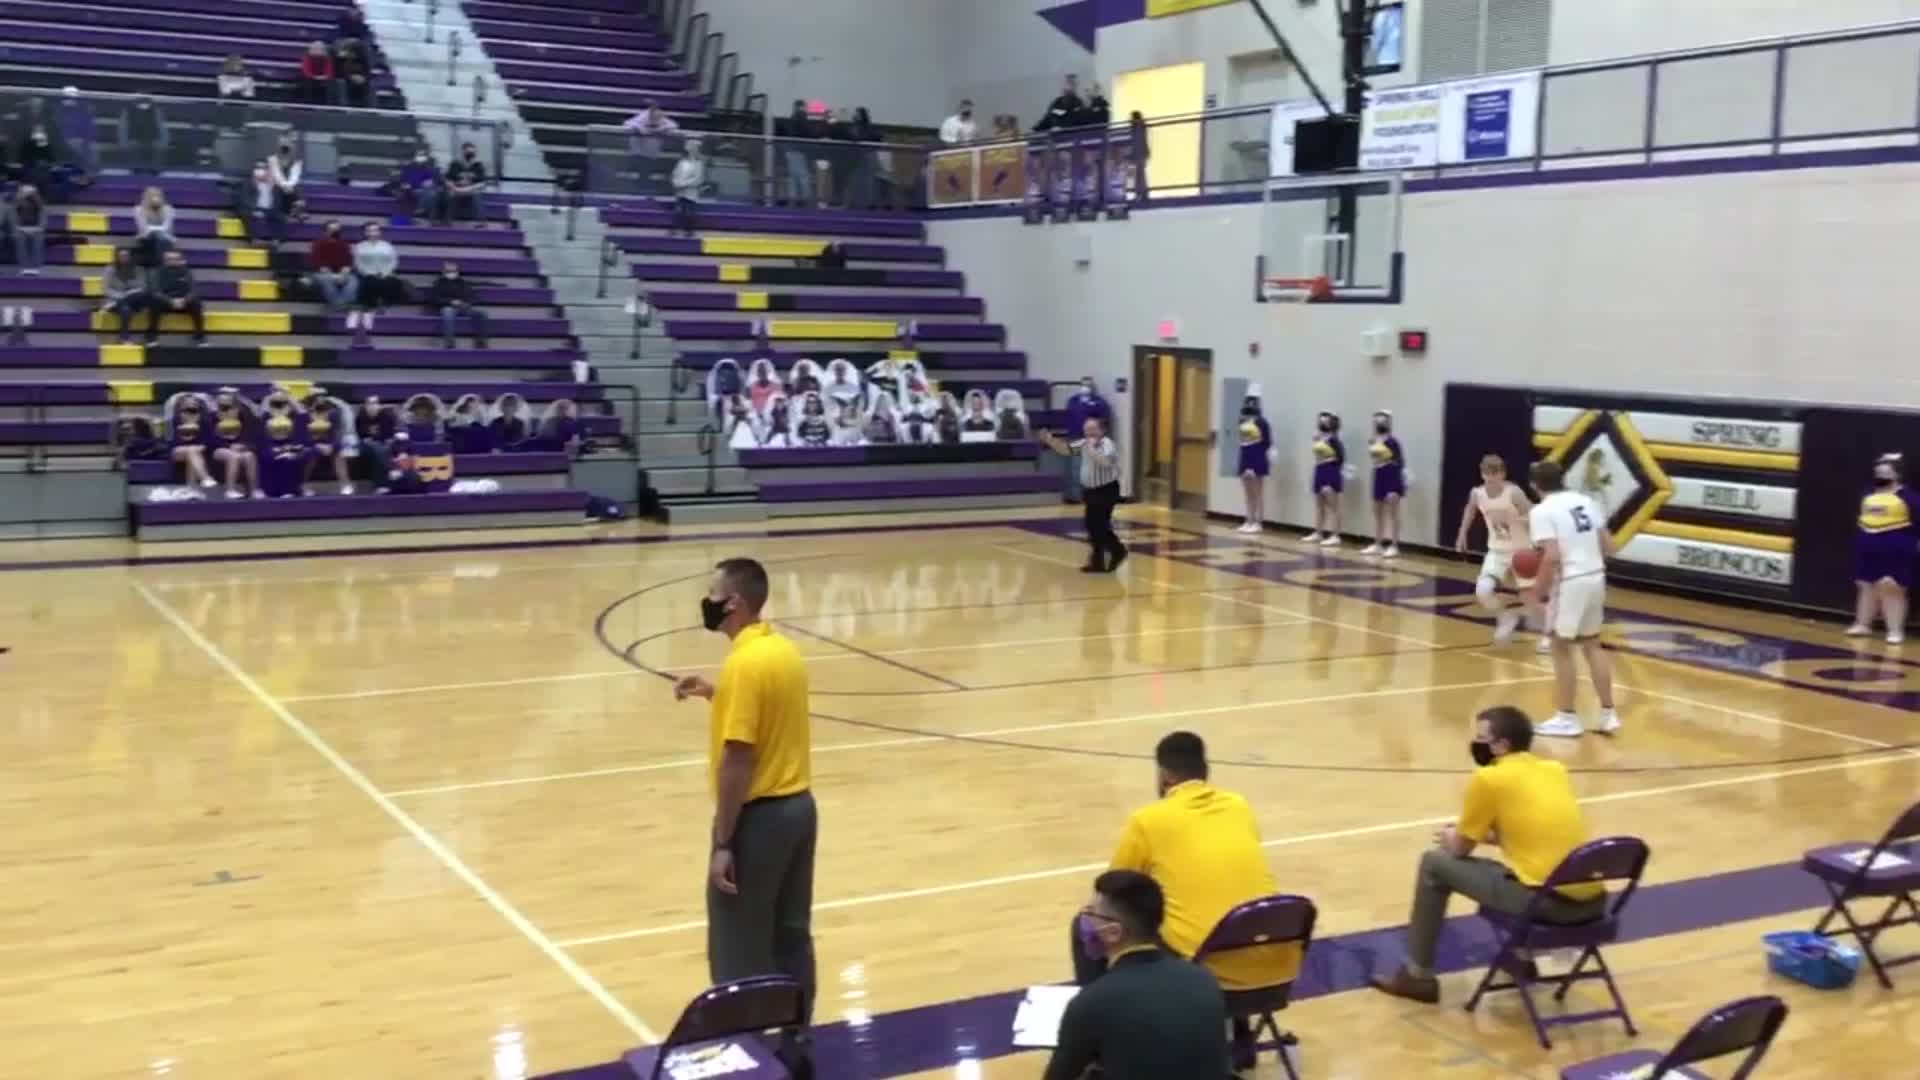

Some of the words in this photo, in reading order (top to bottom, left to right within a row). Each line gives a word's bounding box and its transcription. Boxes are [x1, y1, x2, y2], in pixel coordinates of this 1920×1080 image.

[1690, 421, 1782, 448] SPRING
[1703, 485, 1761, 511] HILL
[1569, 505, 1593, 533] 15
[1676, 544, 1783, 581] BRONCOS
